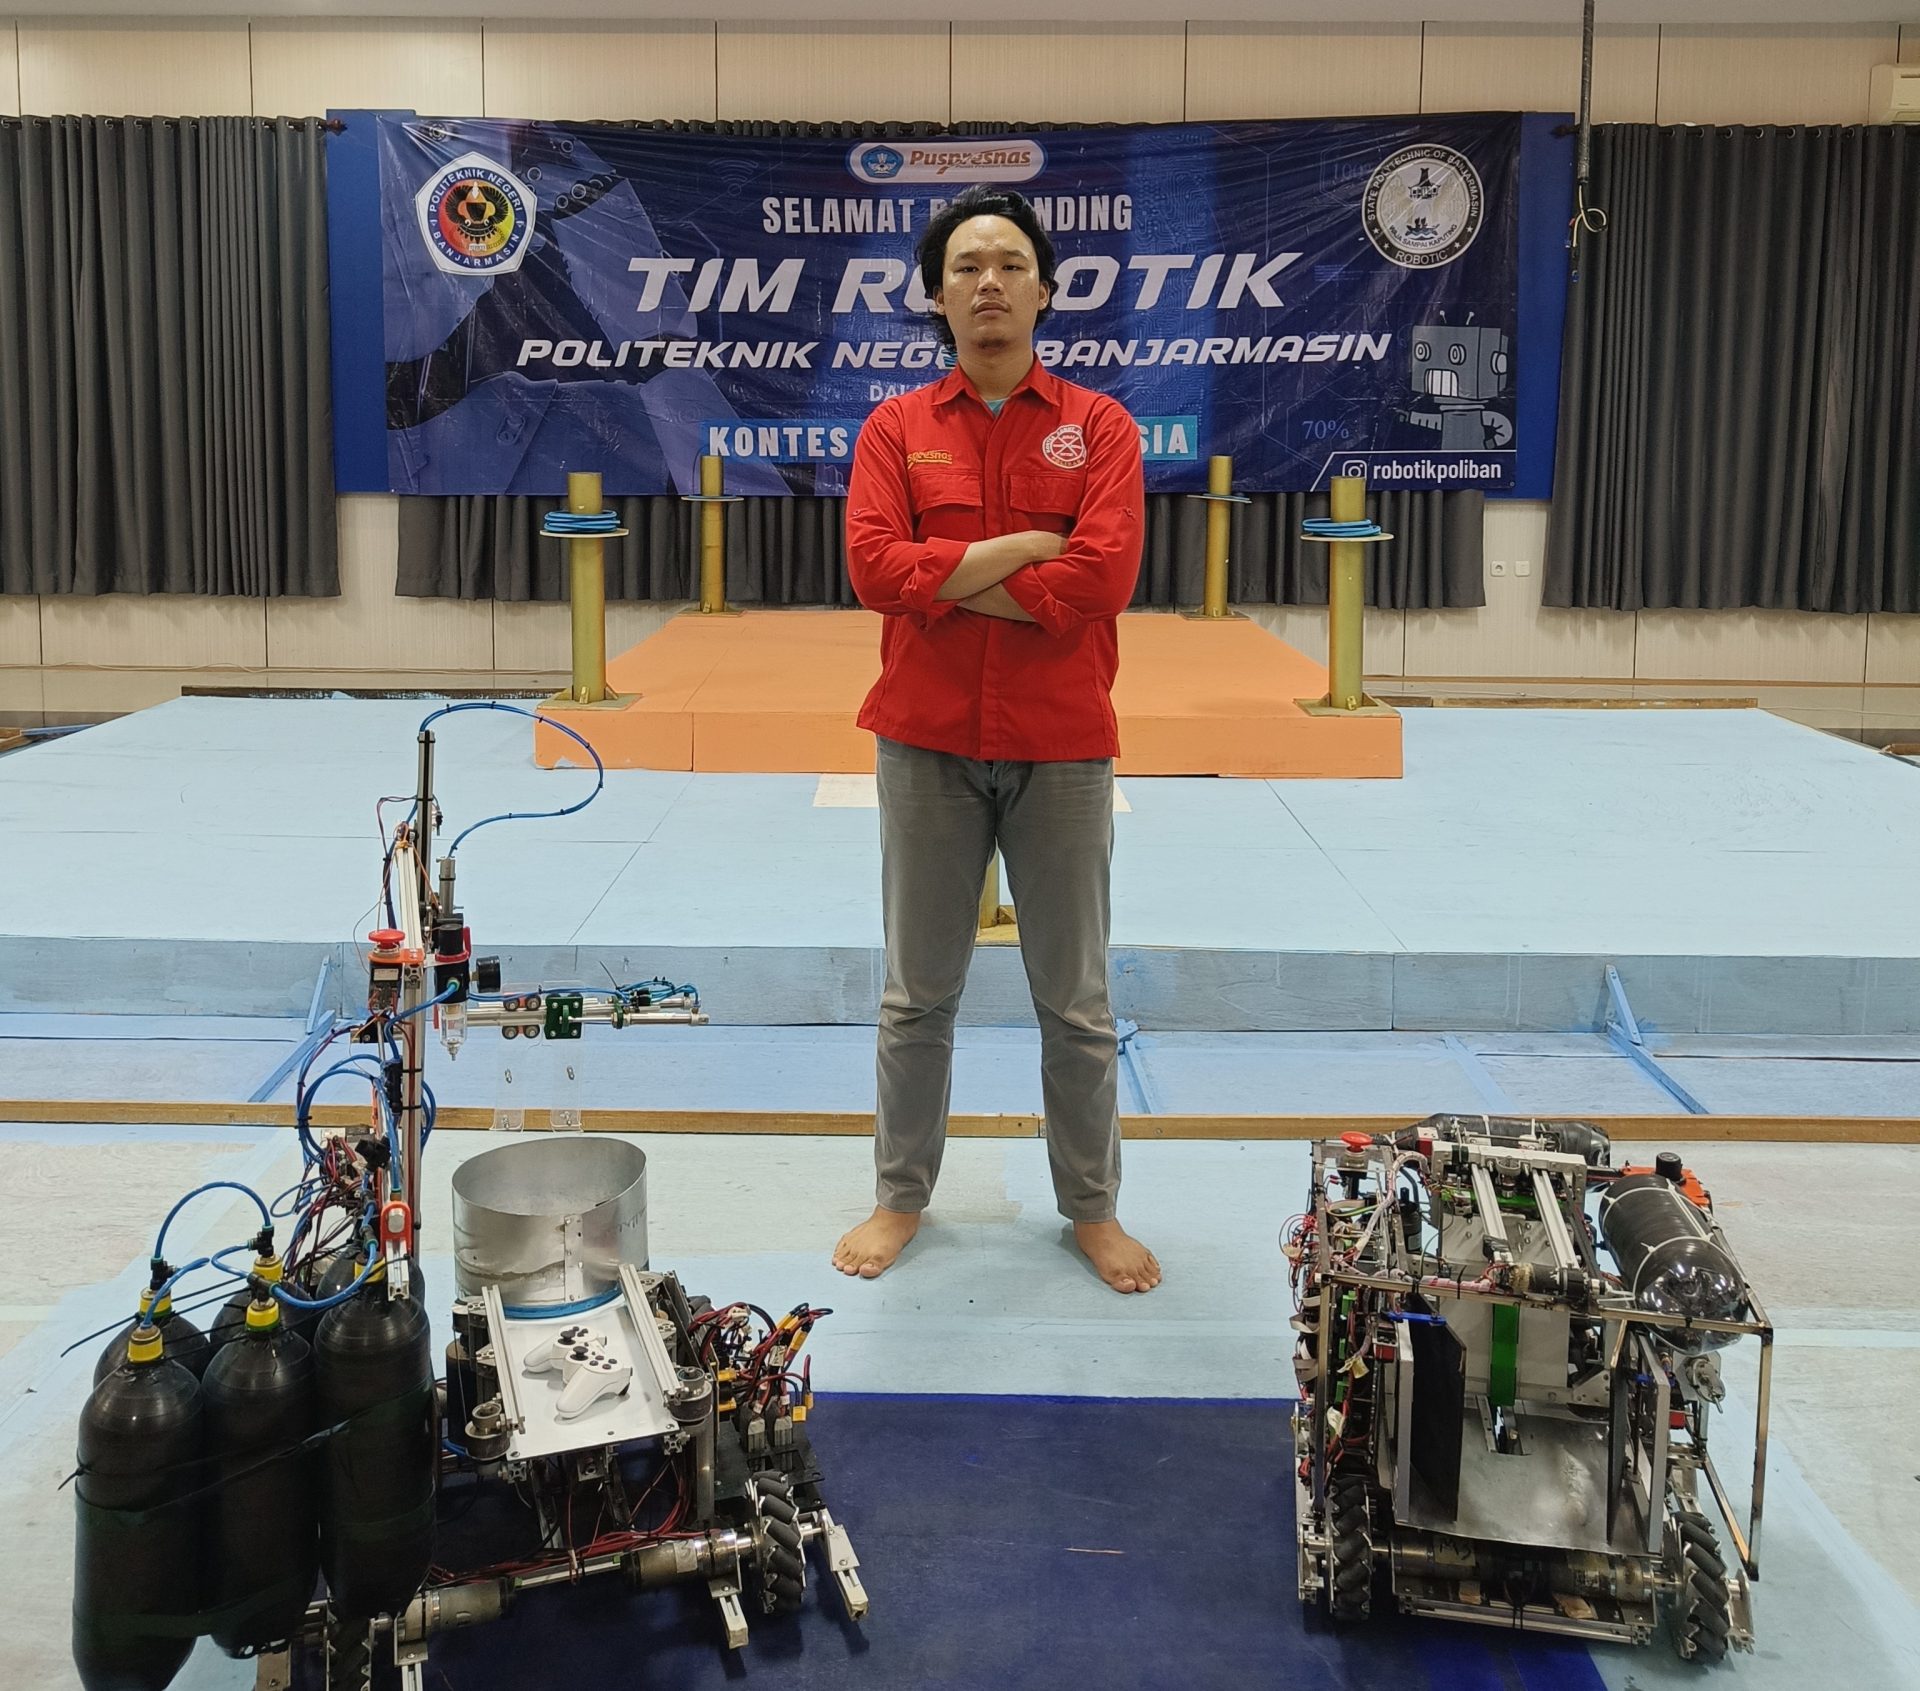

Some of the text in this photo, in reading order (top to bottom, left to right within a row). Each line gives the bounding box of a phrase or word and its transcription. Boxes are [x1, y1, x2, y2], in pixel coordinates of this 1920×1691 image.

[909, 149, 1031, 174] Puspresnas
[429, 168, 524, 213] POLITEKNIK NEGERI
[1367, 150, 1480, 220] STATE POLYTECHNIC OF BANJARMASIN
[762, 197, 914, 234] SELAMAT
[433, 230, 520, 267] BANJARMASIN
[1395, 249, 1449, 265] ROBOTIC
[628, 251, 1303, 314] TIM ROTIK
[516, 339, 820, 370] POLITEKNIK
[1035, 333, 1392, 368] BANJARMASIN
[709, 426, 849, 458] KONTES
[1302, 419, 1349, 440] 70%
[1373, 459, 1502, 484] robotikpoliban
